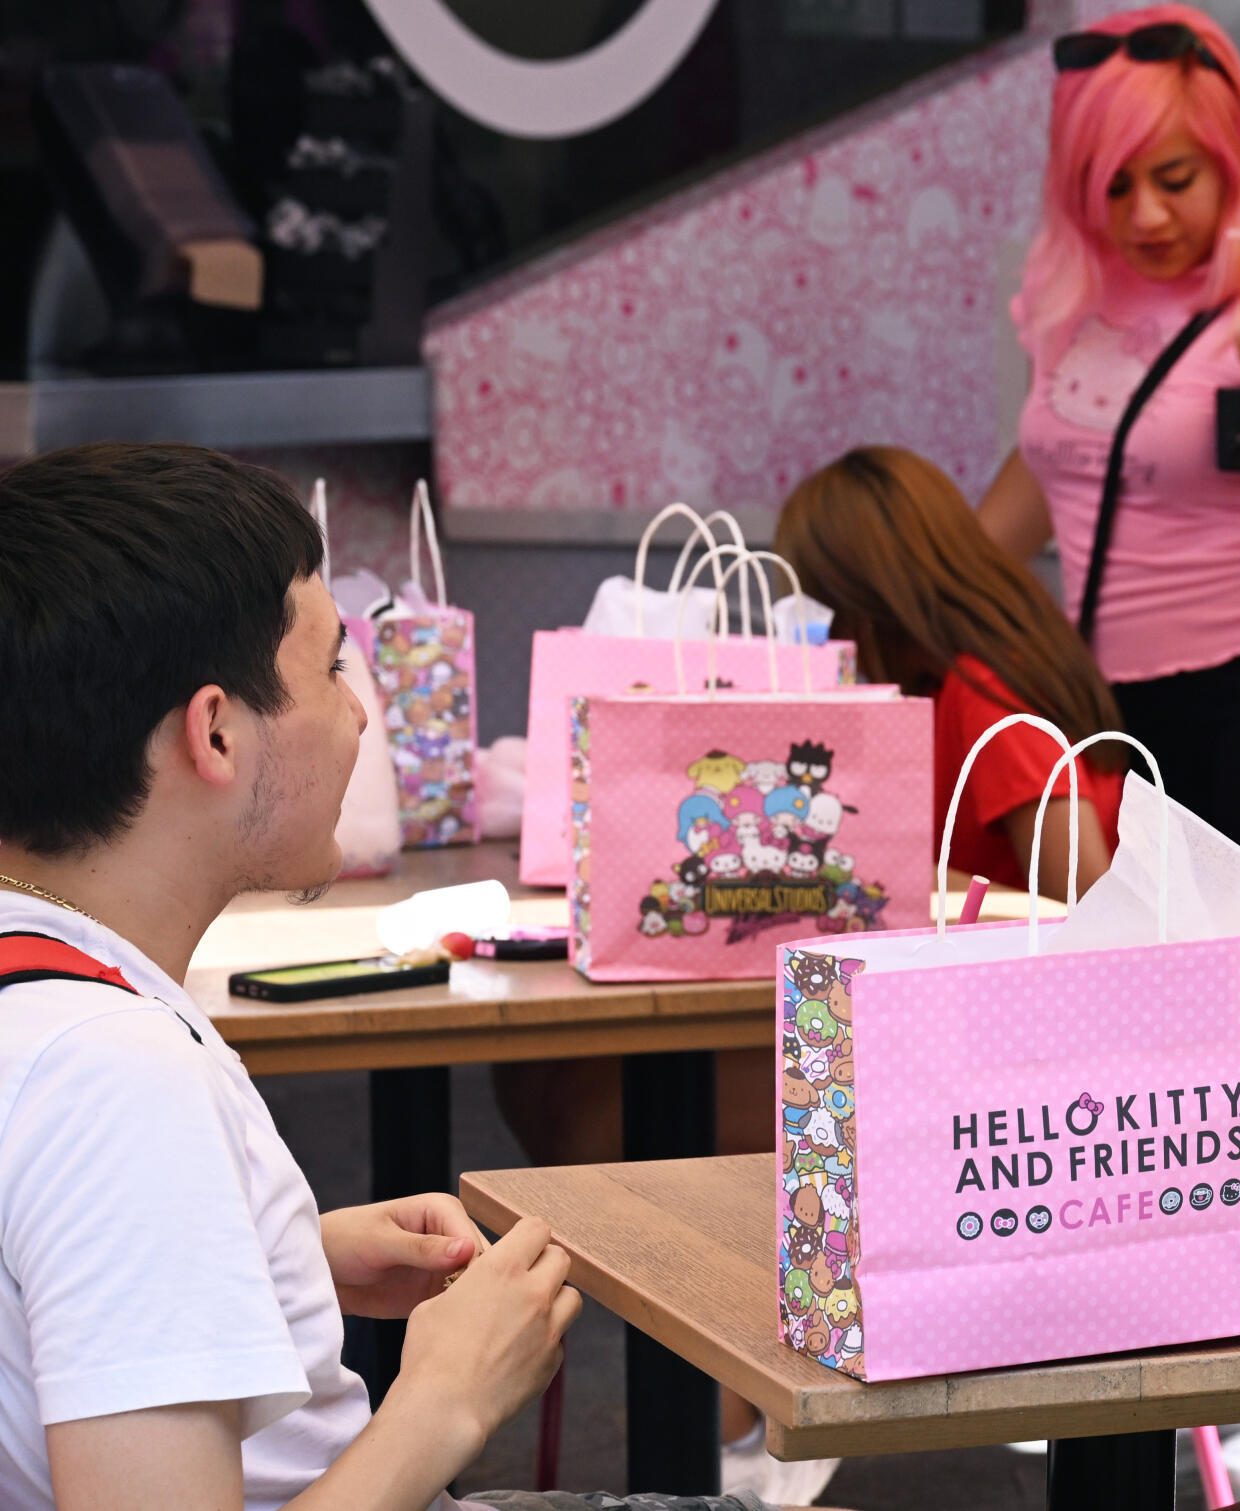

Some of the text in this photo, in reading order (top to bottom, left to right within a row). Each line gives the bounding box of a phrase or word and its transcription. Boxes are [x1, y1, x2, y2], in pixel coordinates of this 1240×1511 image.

[953, 1092, 1104, 1150] HELLO
[954, 1151, 1054, 1194] AND
[1058, 1190, 1154, 1230] CAFE
